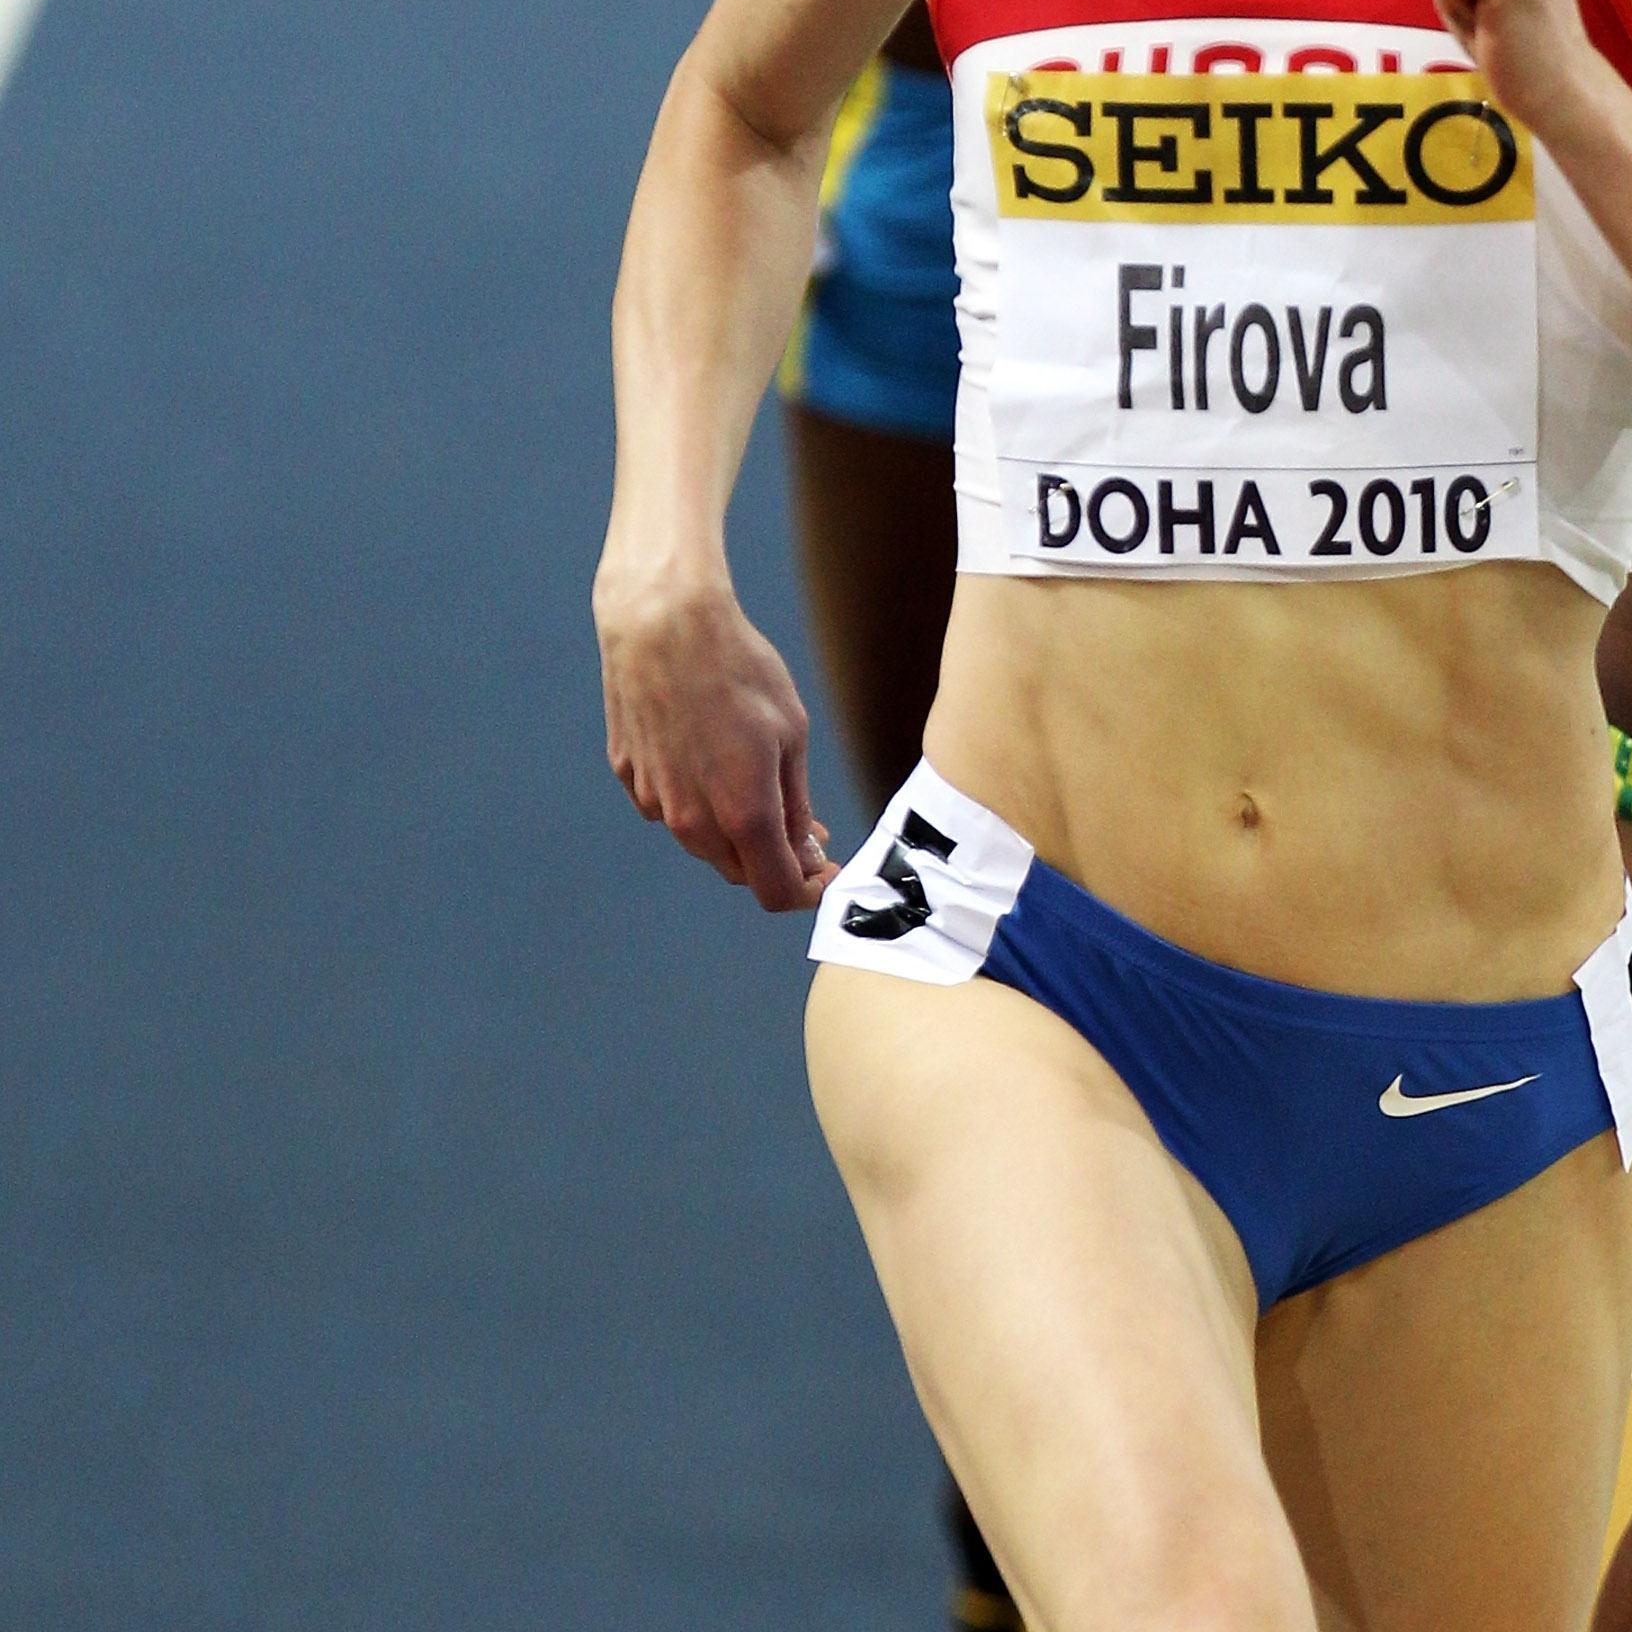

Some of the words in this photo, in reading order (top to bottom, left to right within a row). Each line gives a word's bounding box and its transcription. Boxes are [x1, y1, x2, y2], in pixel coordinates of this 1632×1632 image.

[1004, 100, 1517, 207] SEIKO
[1117, 263, 1387, 415] Firova
[1037, 473, 1281, 556] DOHA
[1309, 474, 1492, 556] 2010
[840, 805, 959, 941] 5
